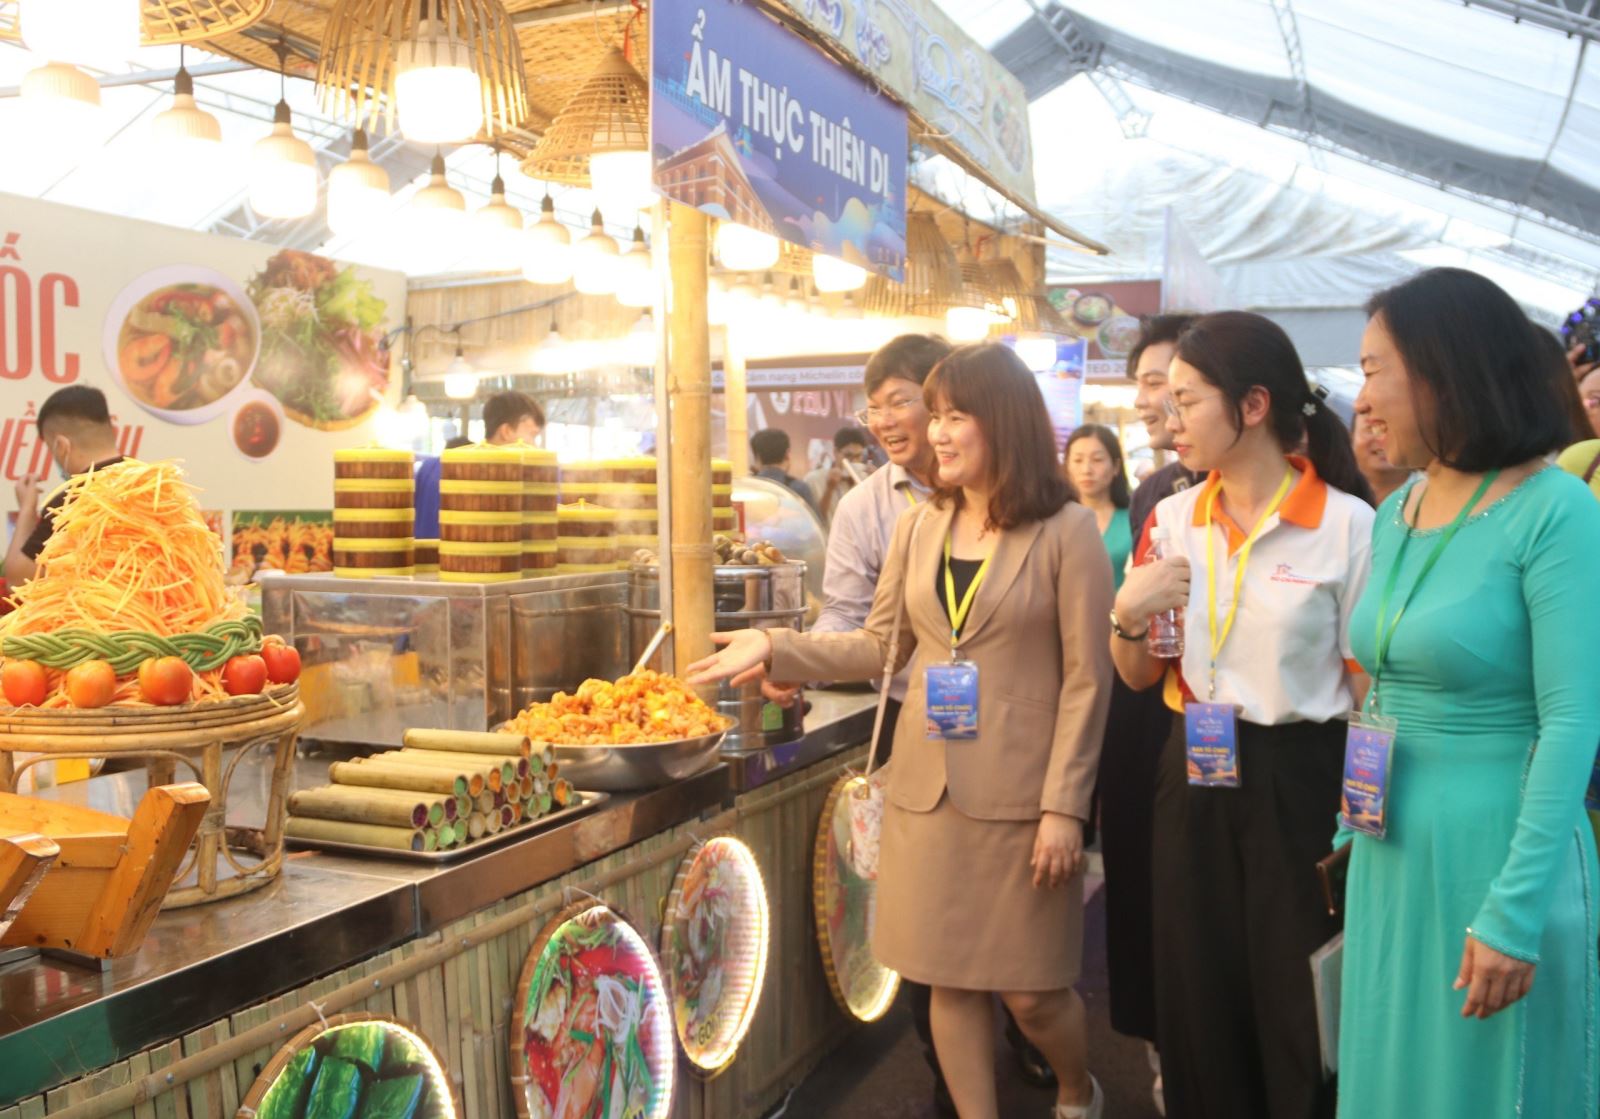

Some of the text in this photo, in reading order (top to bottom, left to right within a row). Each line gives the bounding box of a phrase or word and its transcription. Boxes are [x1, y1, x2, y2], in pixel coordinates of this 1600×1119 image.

[686, 8, 732, 118] ẨM
[739, 68, 804, 160] THỰC
[809, 110, 865, 187] THIÊN
[870, 146, 889, 197] DI
